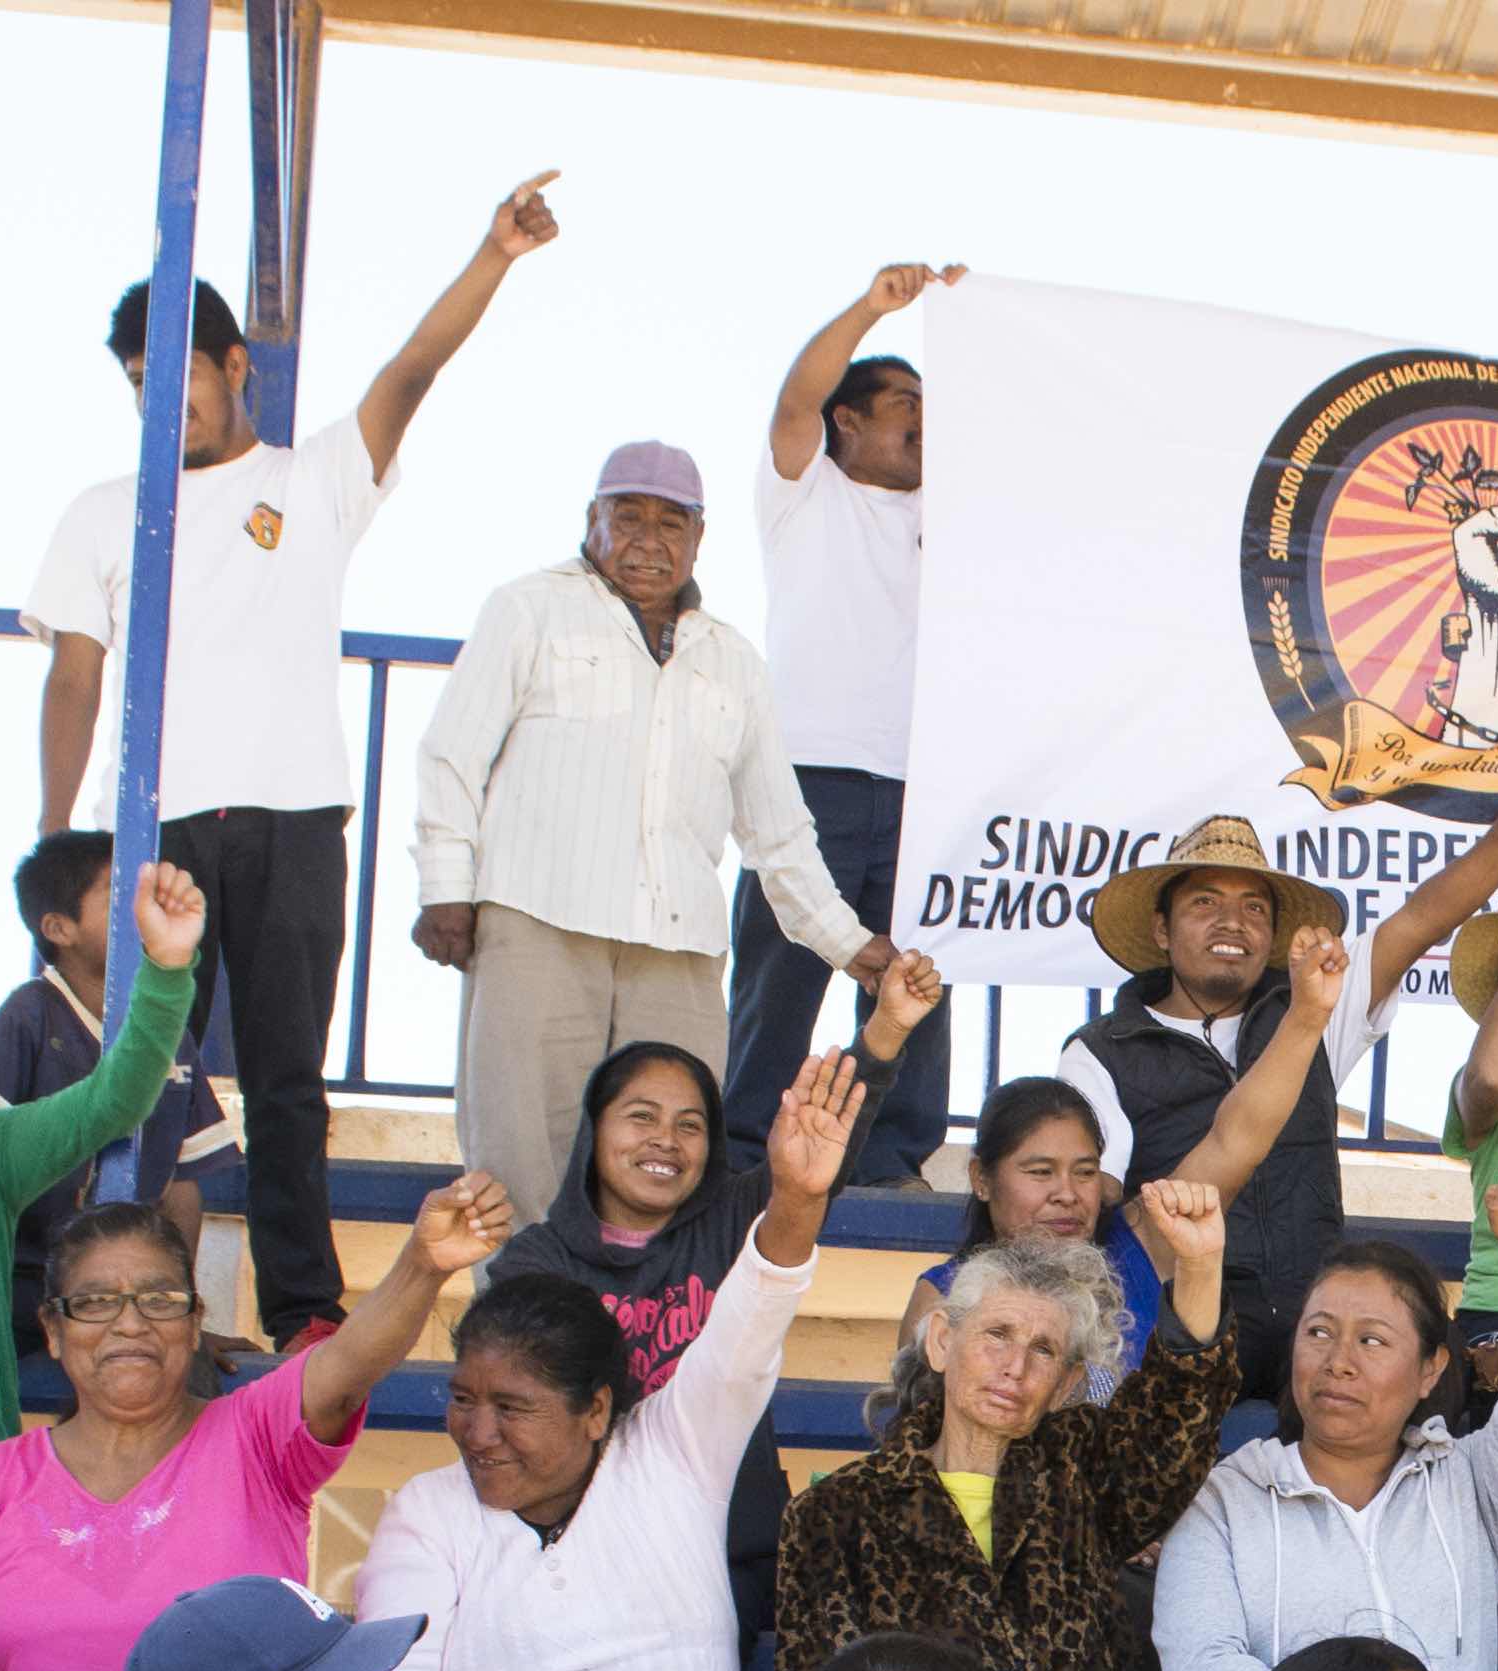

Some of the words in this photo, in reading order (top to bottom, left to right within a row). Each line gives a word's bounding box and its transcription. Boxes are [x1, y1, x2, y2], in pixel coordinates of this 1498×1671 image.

[1269, 466, 1303, 562] SINDICATO
[1291, 372, 1393, 471] INDEPENDIENTE
[1390, 360, 1474, 388] NACIONAL
[980, 816, 1178, 878] SINDIC
